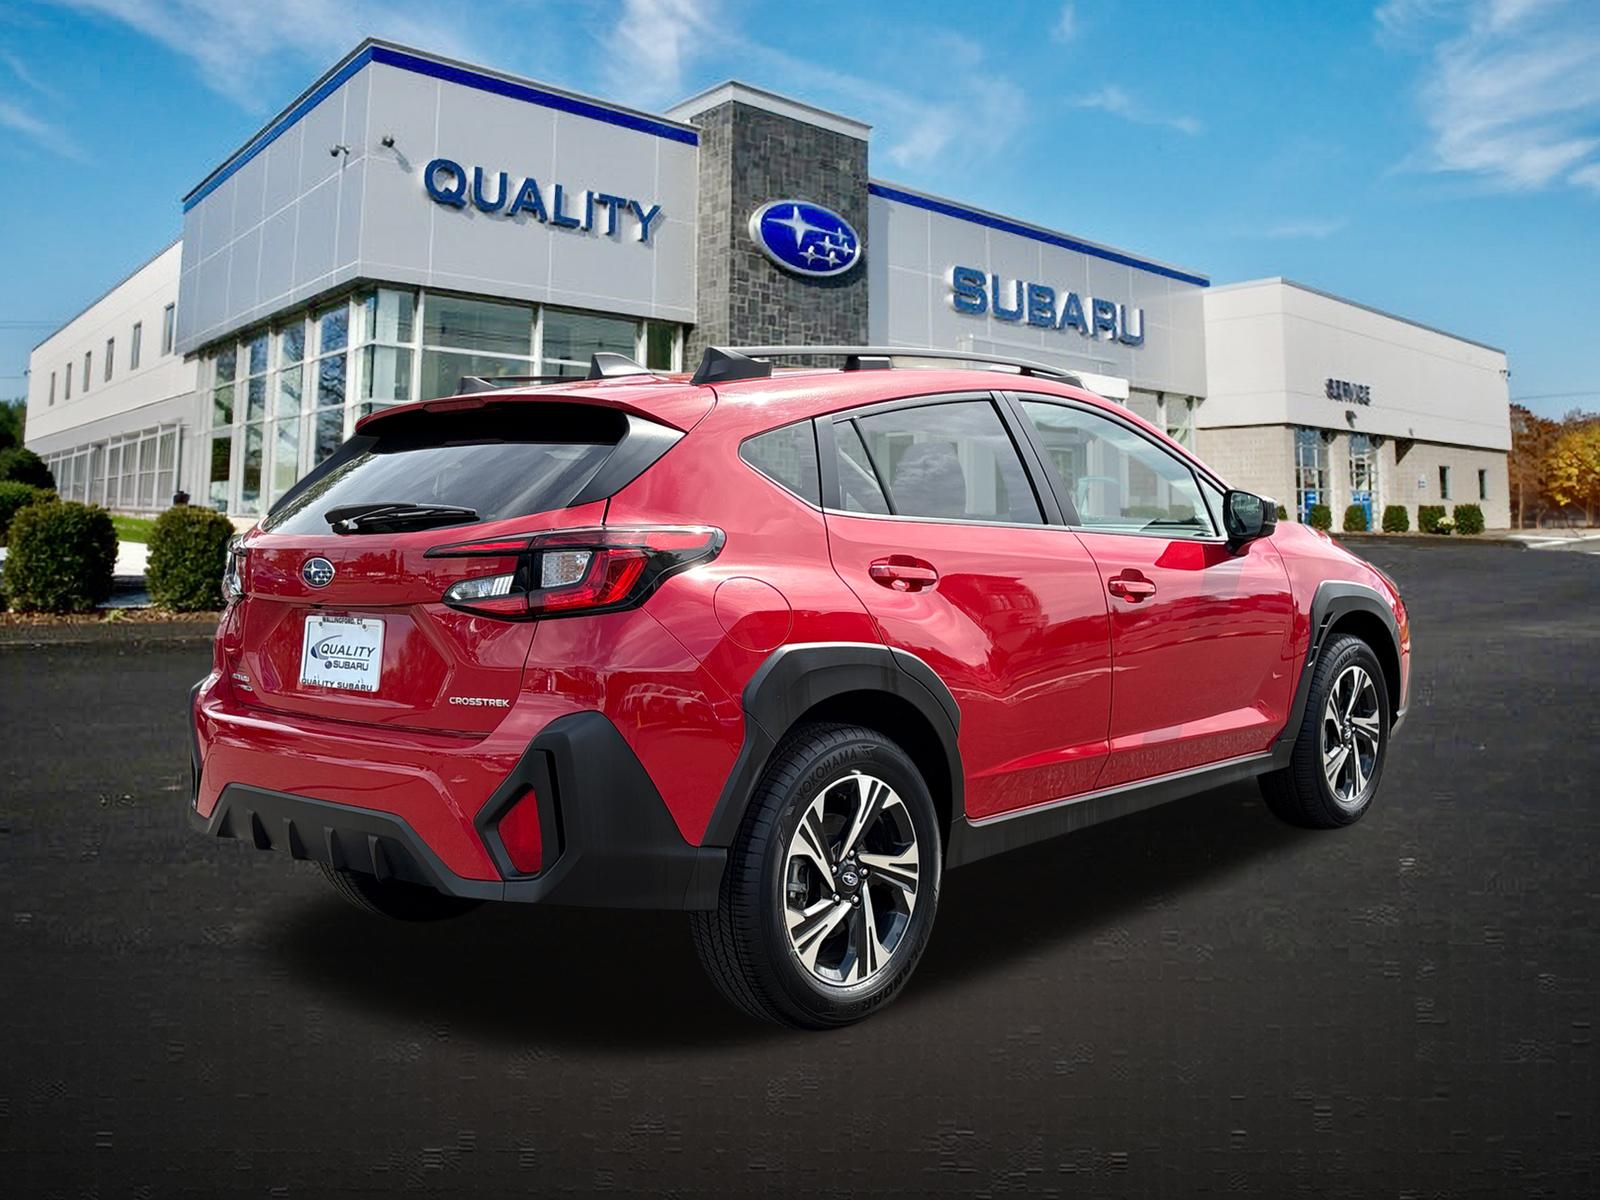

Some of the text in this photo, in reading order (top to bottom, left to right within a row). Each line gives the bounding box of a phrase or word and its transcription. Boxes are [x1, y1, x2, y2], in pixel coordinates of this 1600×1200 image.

[424, 158, 661, 243] QUALITY
[951, 265, 1144, 346] SUBARU
[1324, 378, 1370, 406] SERVICE
[321, 643, 376, 658] QUALITY
[333, 660, 370, 671] SUBARU
[302, 678, 373, 691] QUALITY SUBARU
[449, 696, 510, 708] CROSSTREK
[795, 748, 857, 799] YOKOHAMA
